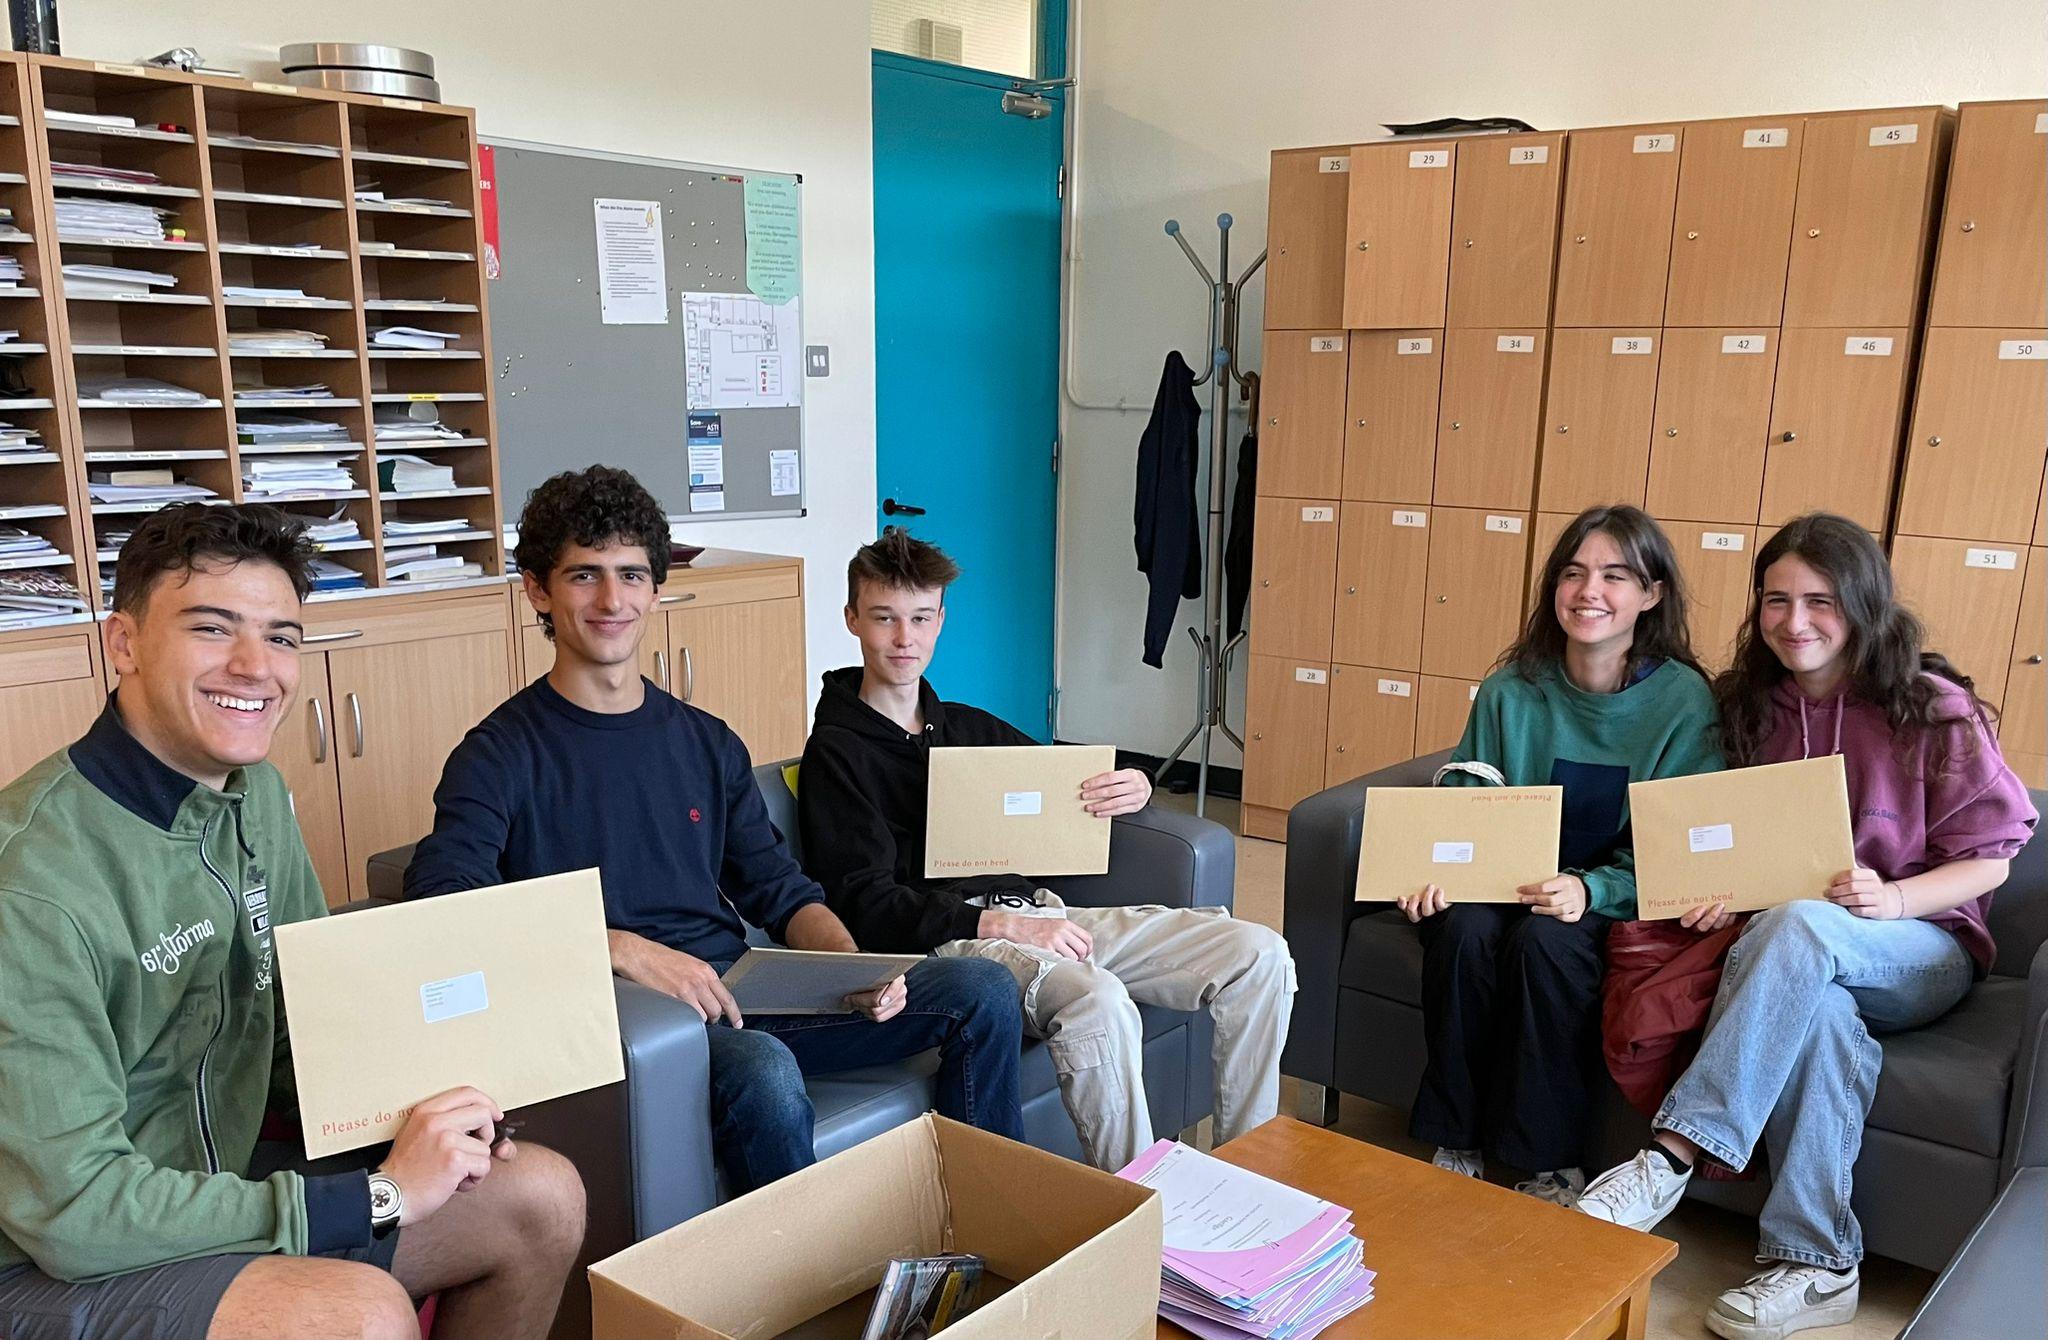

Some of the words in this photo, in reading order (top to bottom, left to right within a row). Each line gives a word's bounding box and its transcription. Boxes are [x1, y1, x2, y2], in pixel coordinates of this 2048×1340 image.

[1758, 133, 1771, 144] 41
[1886, 130, 1900, 141] 45
[1648, 138, 1661, 149] 37
[1423, 154, 1435, 165] 29
[1523, 150, 1534, 161] 33
[1329, 160, 1341, 171] 25
[1320, 340, 1333, 351] 26
[1410, 342, 1421, 351] 30
[1510, 339, 1521, 349] 34
[1626, 341, 1639, 351] 38
[1737, 340, 1750, 350] 42
[1862, 341, 1876, 352] 46
[2017, 344, 2033, 355] 50
[1312, 510, 1323, 520] 27
[1405, 514, 1414, 524] 31
[1499, 519, 1509, 529] 35
[1716, 537, 1729, 547] 43
[1983, 554, 1997, 565] 51
[1306, 672, 1316, 680] 28
[1389, 683, 1399, 692] 32
[934, 859, 960, 867] Please
[962, 859, 972, 867] do
[1647, 899, 1676, 908] Please
[1680, 896, 1690, 905] do
[1694, 895, 1708, 903] not
[1711, 891, 1734, 902] bend
[322, 1117, 369, 1136] Please
[374, 1111, 392, 1124] do
[397, 1106, 414, 1119] no
